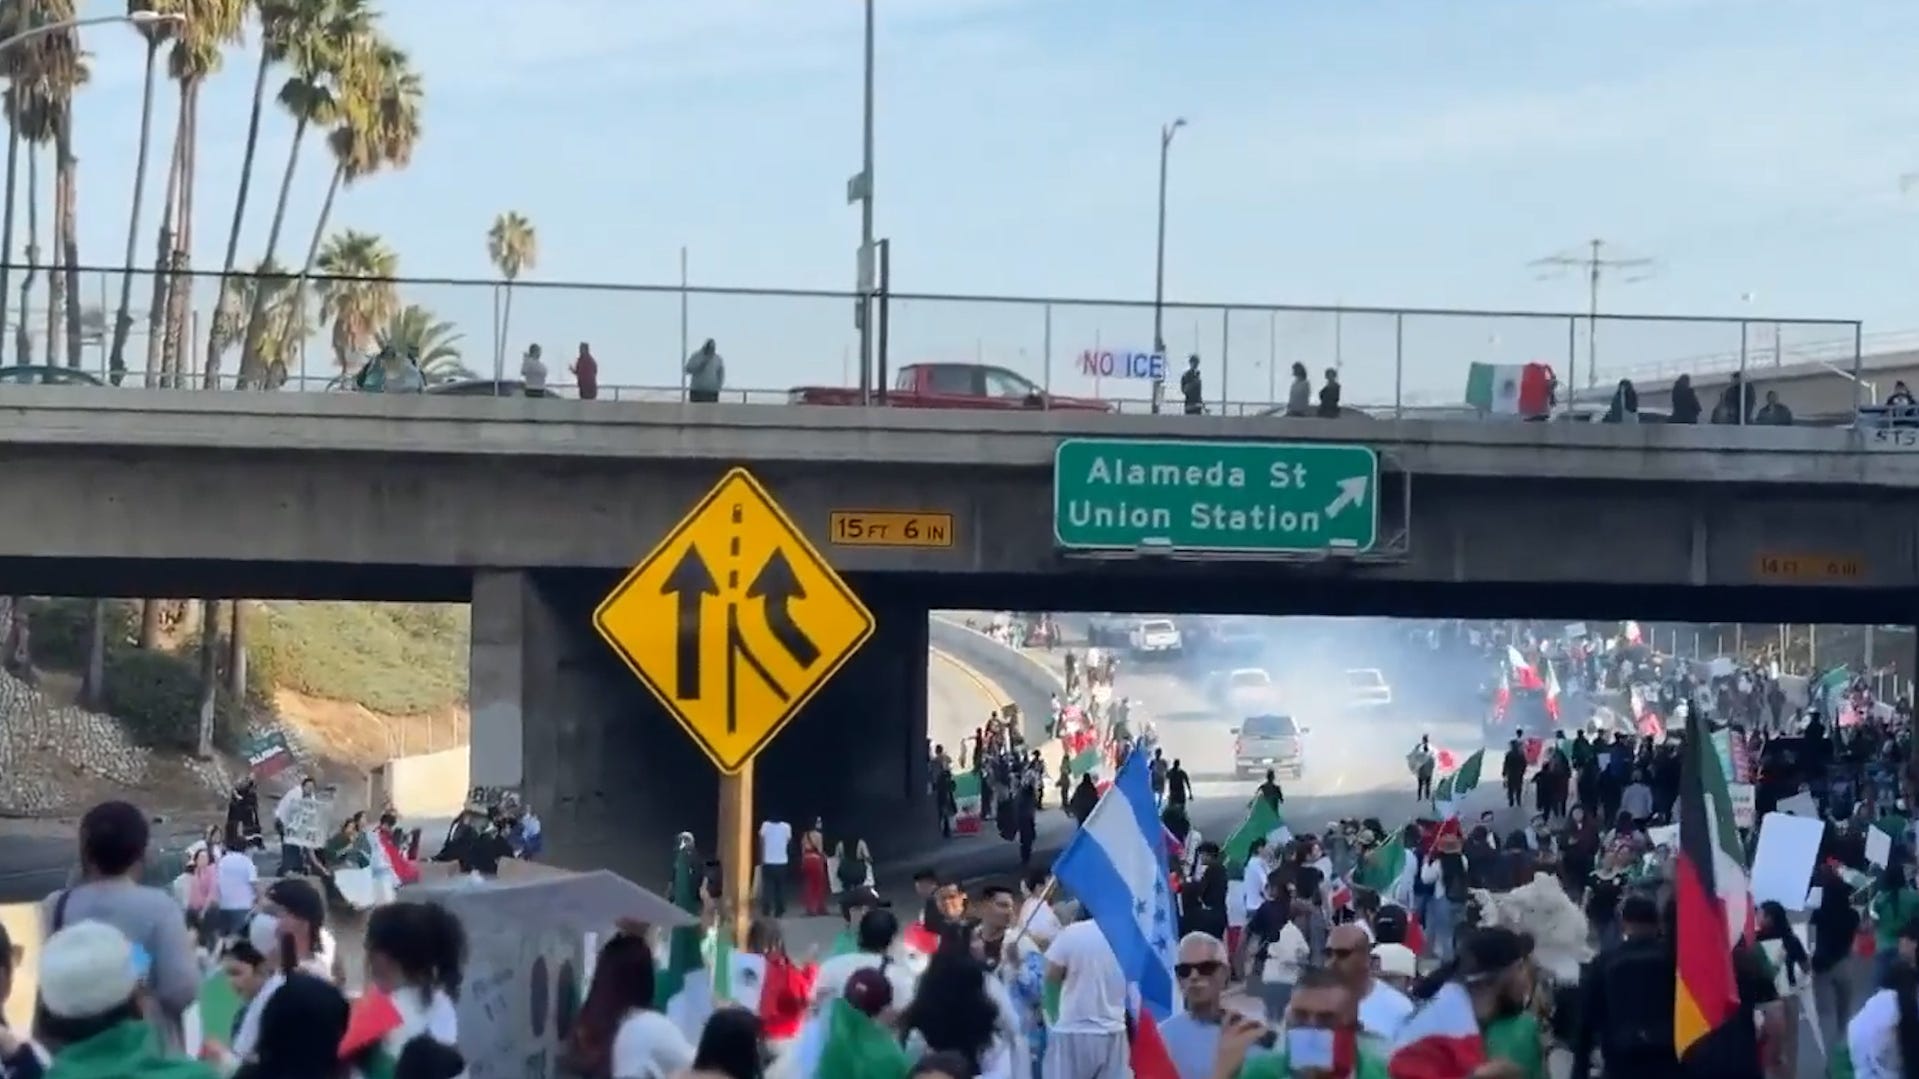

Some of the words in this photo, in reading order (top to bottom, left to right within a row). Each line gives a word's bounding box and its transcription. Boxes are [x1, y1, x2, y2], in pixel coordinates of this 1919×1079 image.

[1082, 350, 1115, 376] NO
[1125, 352, 1163, 379] ICE
[1086, 457, 1246, 487] Alameda
[1269, 461, 1307, 489] St
[903, 518, 920, 539] 6
[926, 524, 945, 541] IN
[1068, 500, 1171, 529] Union
[1190, 502, 1320, 533] Station
